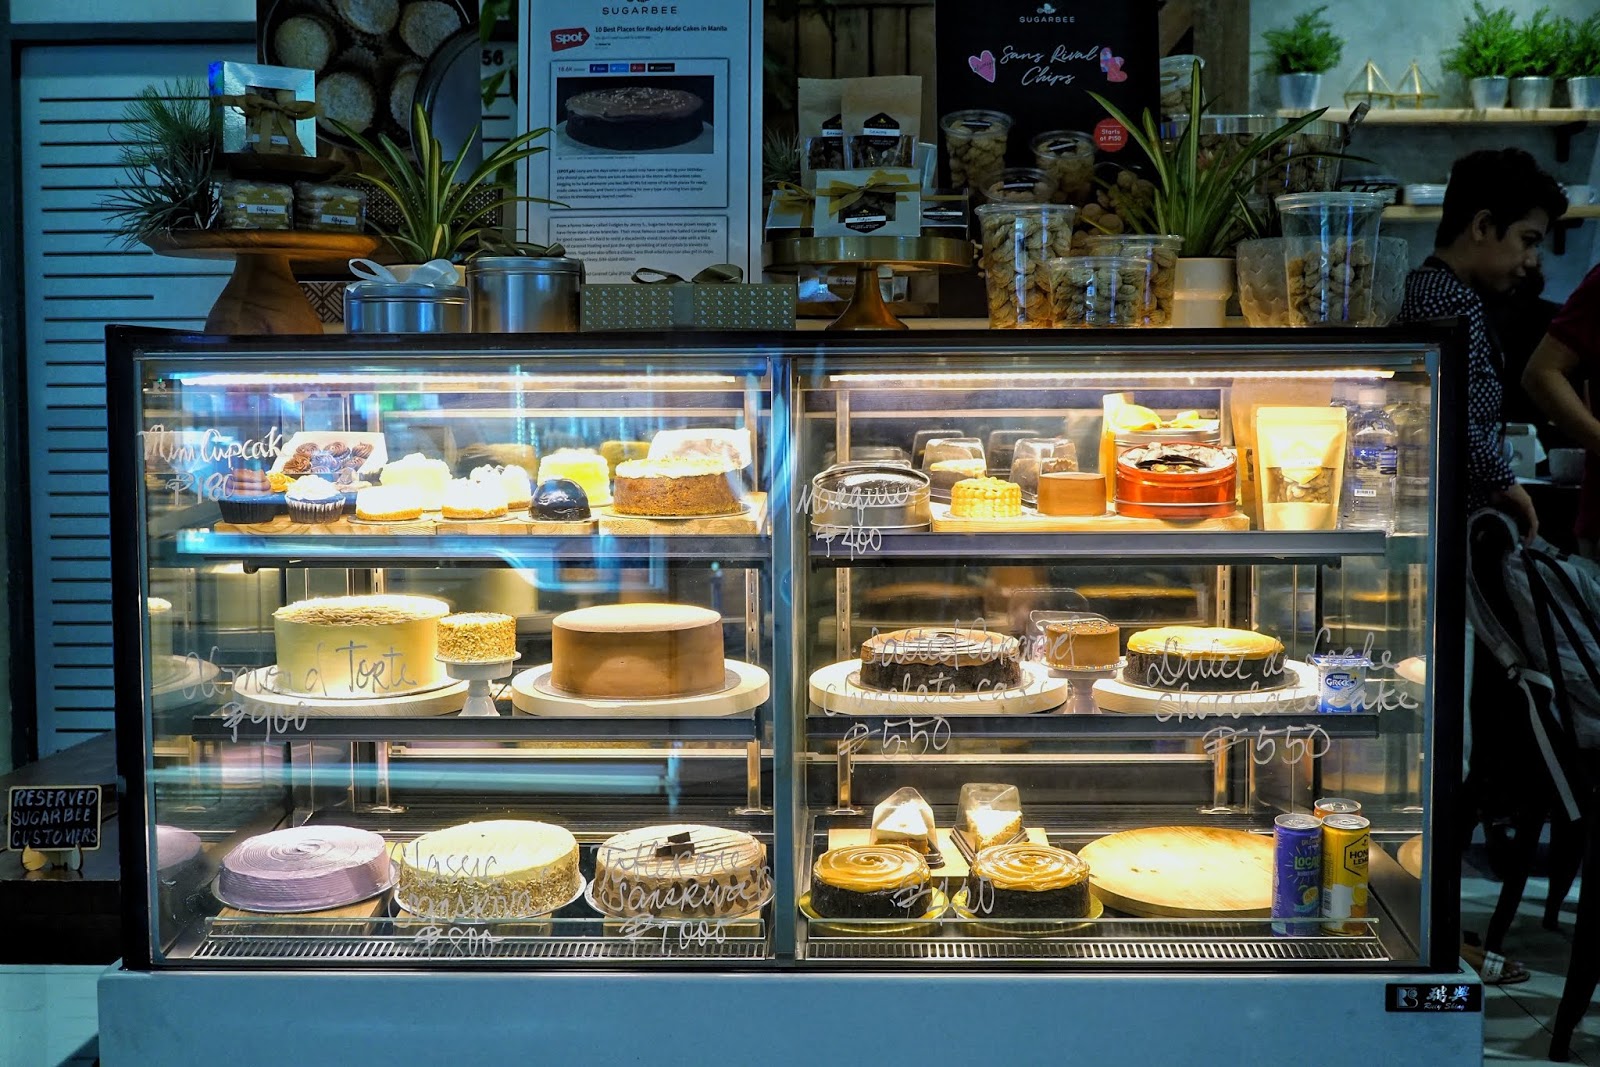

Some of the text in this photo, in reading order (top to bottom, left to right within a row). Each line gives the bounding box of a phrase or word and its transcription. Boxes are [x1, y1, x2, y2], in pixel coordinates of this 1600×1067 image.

[602, 6, 677, 15] SUGARBEE
[555, 32, 583, 44] spot
[1000, 44, 1099, 64] Sans Rival
[1021, 66, 1075, 86] Chips
[13, 790, 98, 808] RESERVED
[12, 828, 98, 846] CUSTOMERS
[1350, 849, 1368, 859] HON
